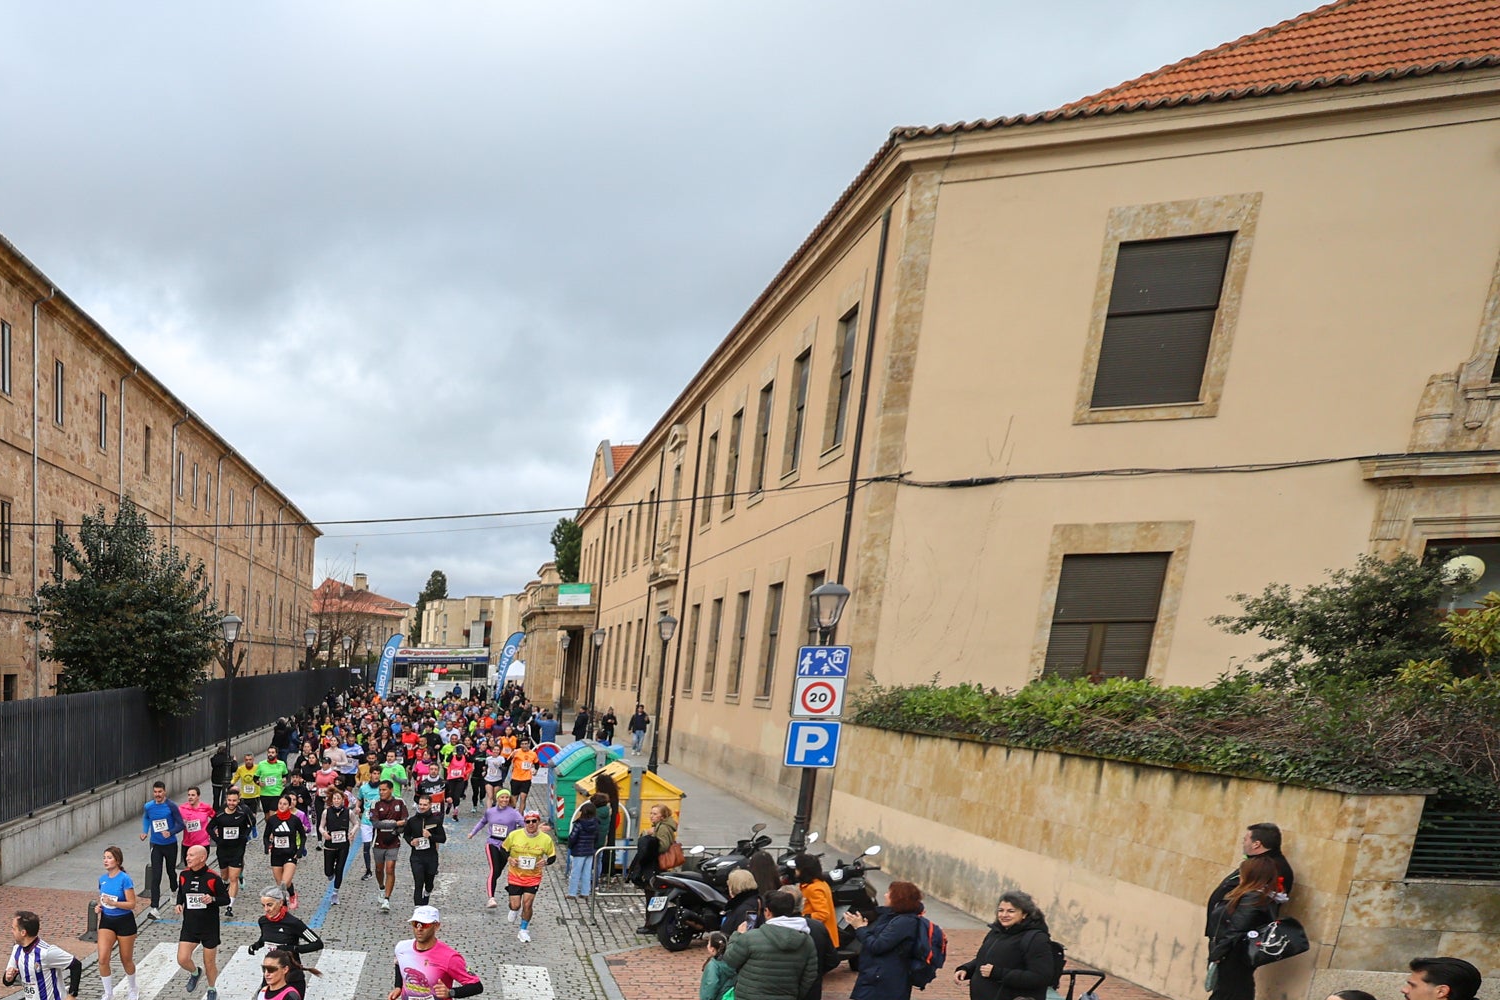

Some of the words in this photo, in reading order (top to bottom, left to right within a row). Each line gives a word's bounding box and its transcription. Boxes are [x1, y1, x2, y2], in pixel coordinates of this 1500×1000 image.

[809, 692, 827, 703] 20
[793, 725, 829, 762] P
[522, 858, 532, 866] 31
